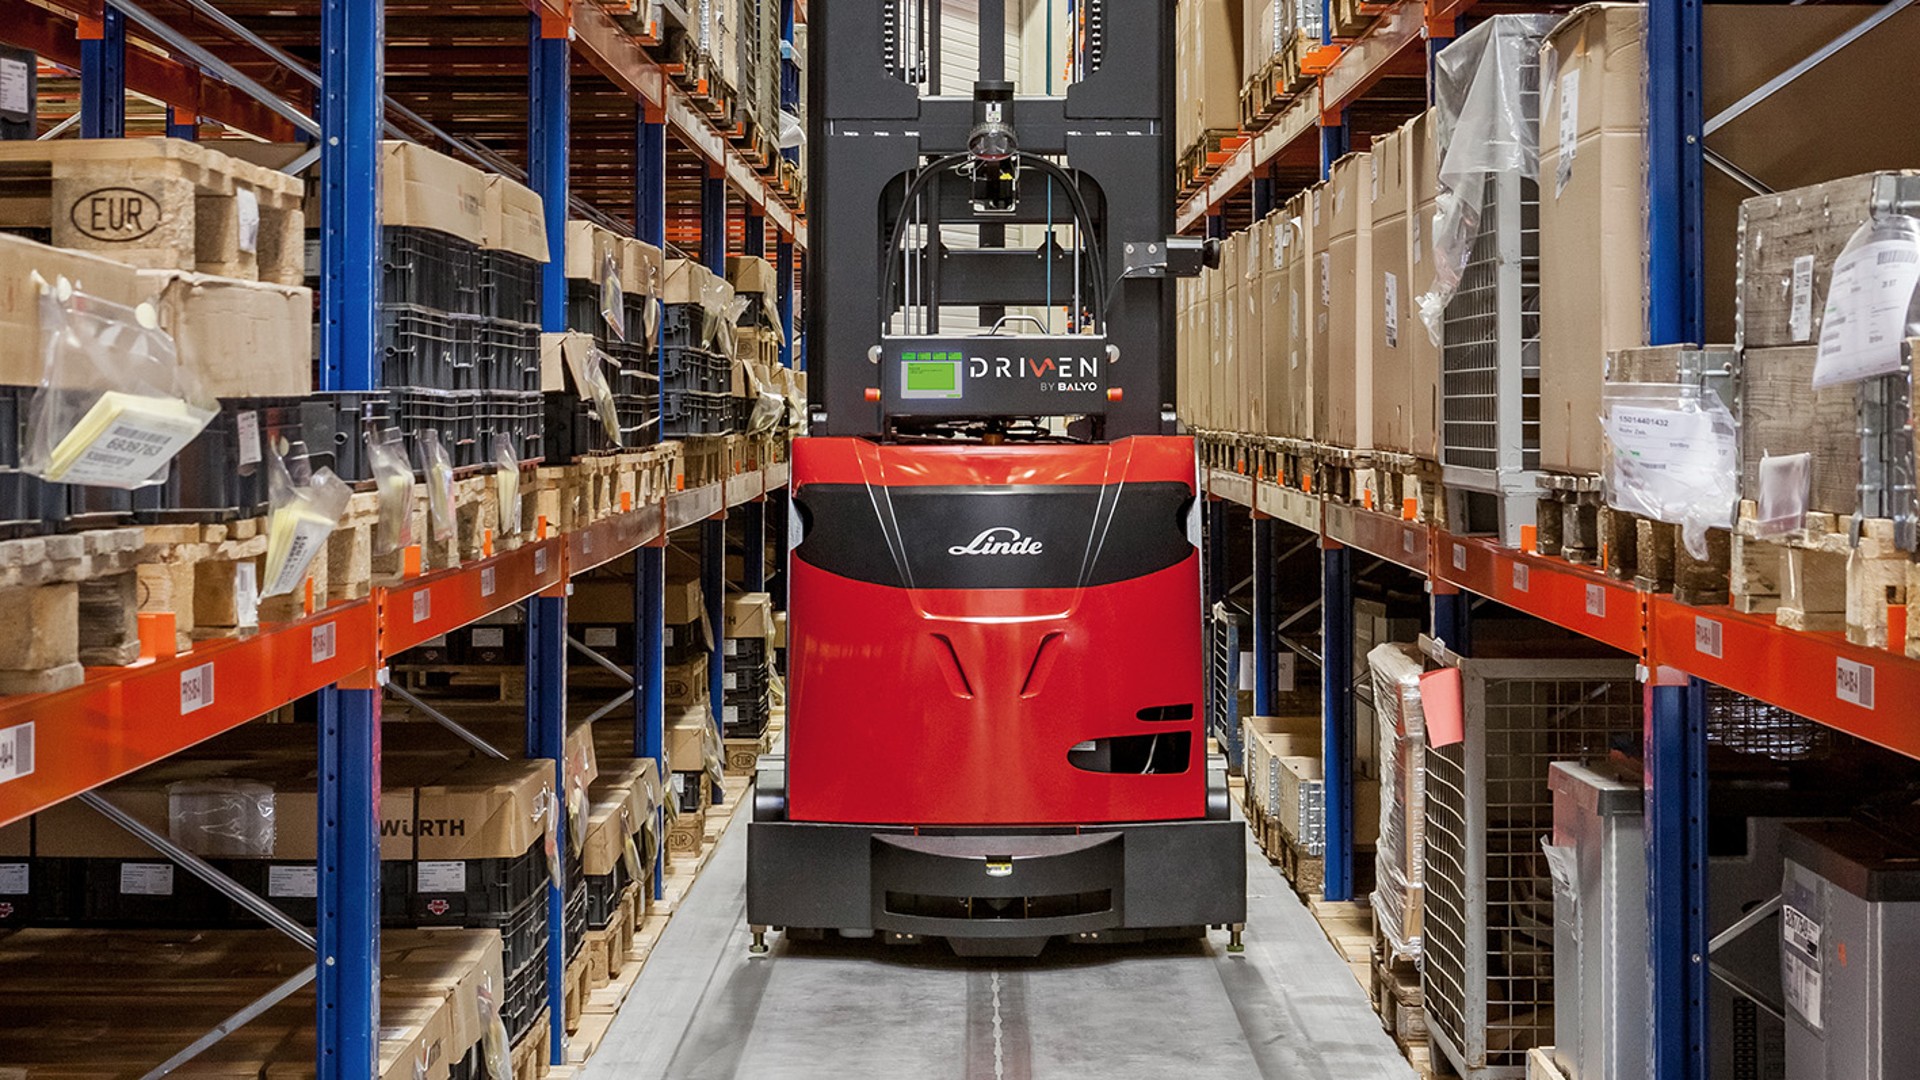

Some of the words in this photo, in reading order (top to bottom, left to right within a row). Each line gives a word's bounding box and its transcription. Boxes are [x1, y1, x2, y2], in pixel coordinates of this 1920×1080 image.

[91, 197, 143, 231] EUR
[1040, 382, 1055, 391] BY
[1057, 382, 1098, 392] BALYO
[948, 527, 1043, 555] Linde
[380, 819, 465, 836] WÜRTH
